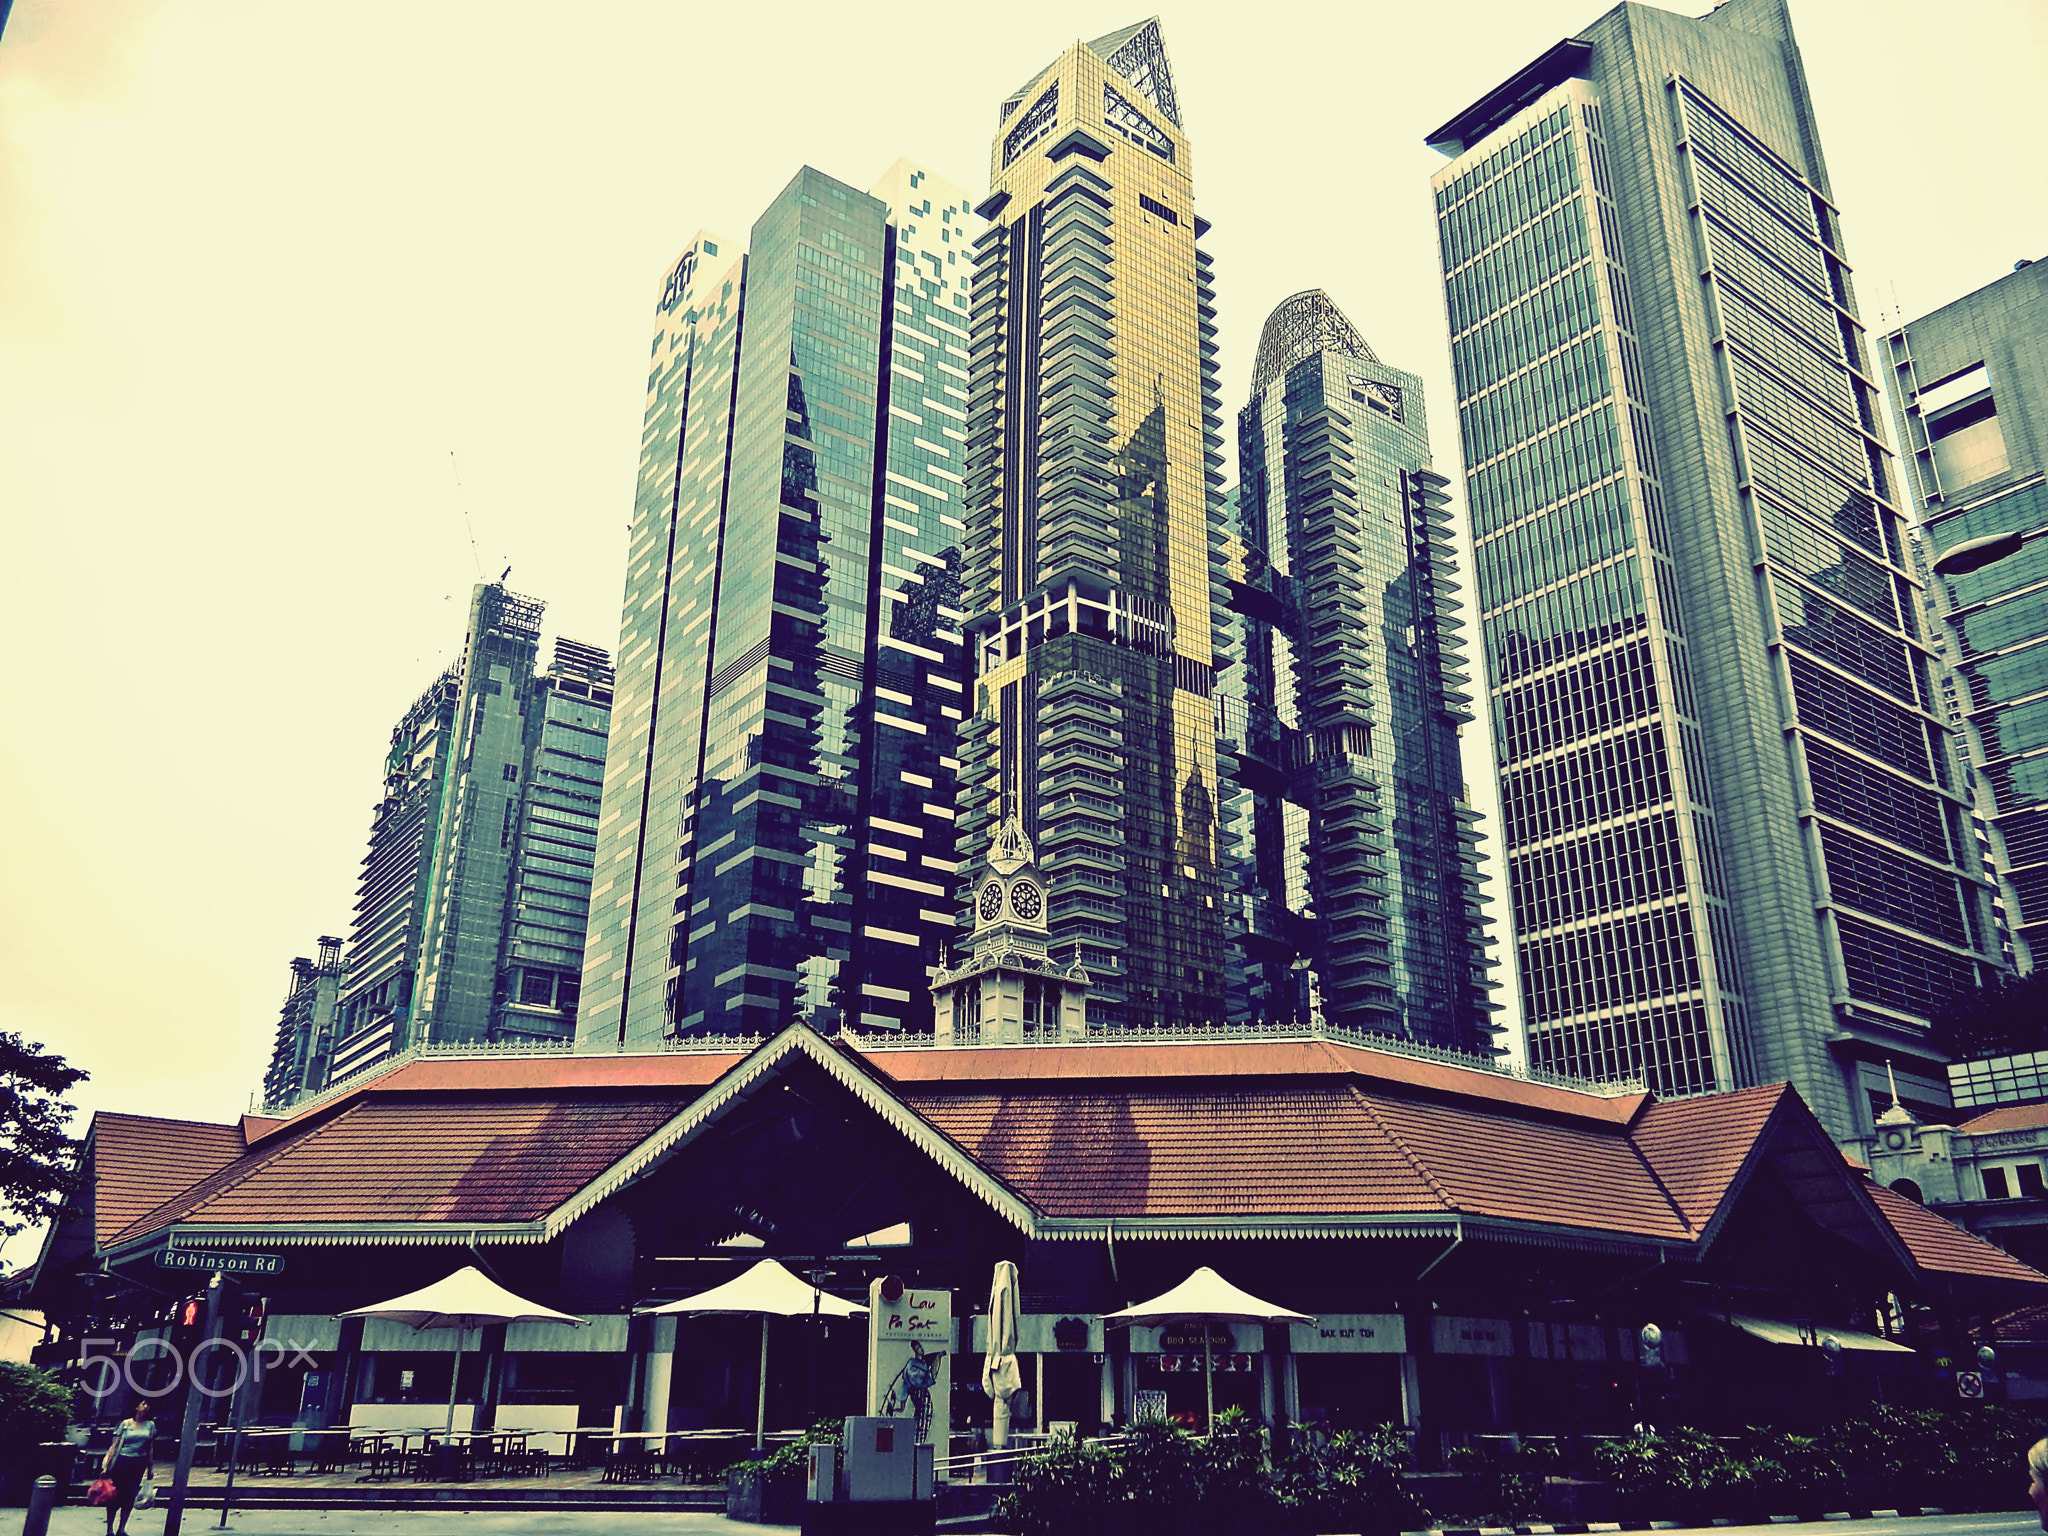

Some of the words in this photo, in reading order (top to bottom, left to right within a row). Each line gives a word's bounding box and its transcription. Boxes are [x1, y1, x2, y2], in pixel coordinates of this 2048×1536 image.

[662, 251, 694, 311] citi
[164, 1251, 248, 1270] Robinson
[255, 1257, 276, 1271] Rd
[909, 1293, 936, 1309] Lau
[888, 1314, 903, 1330] Pa
[908, 1316, 937, 1331] Sat
[1188, 1336, 1226, 1345] SEAOOD
[1321, 1329, 1335, 1338] BAK
[1340, 1329, 1354, 1338] KUT
[1360, 1329, 1374, 1338] TEH
